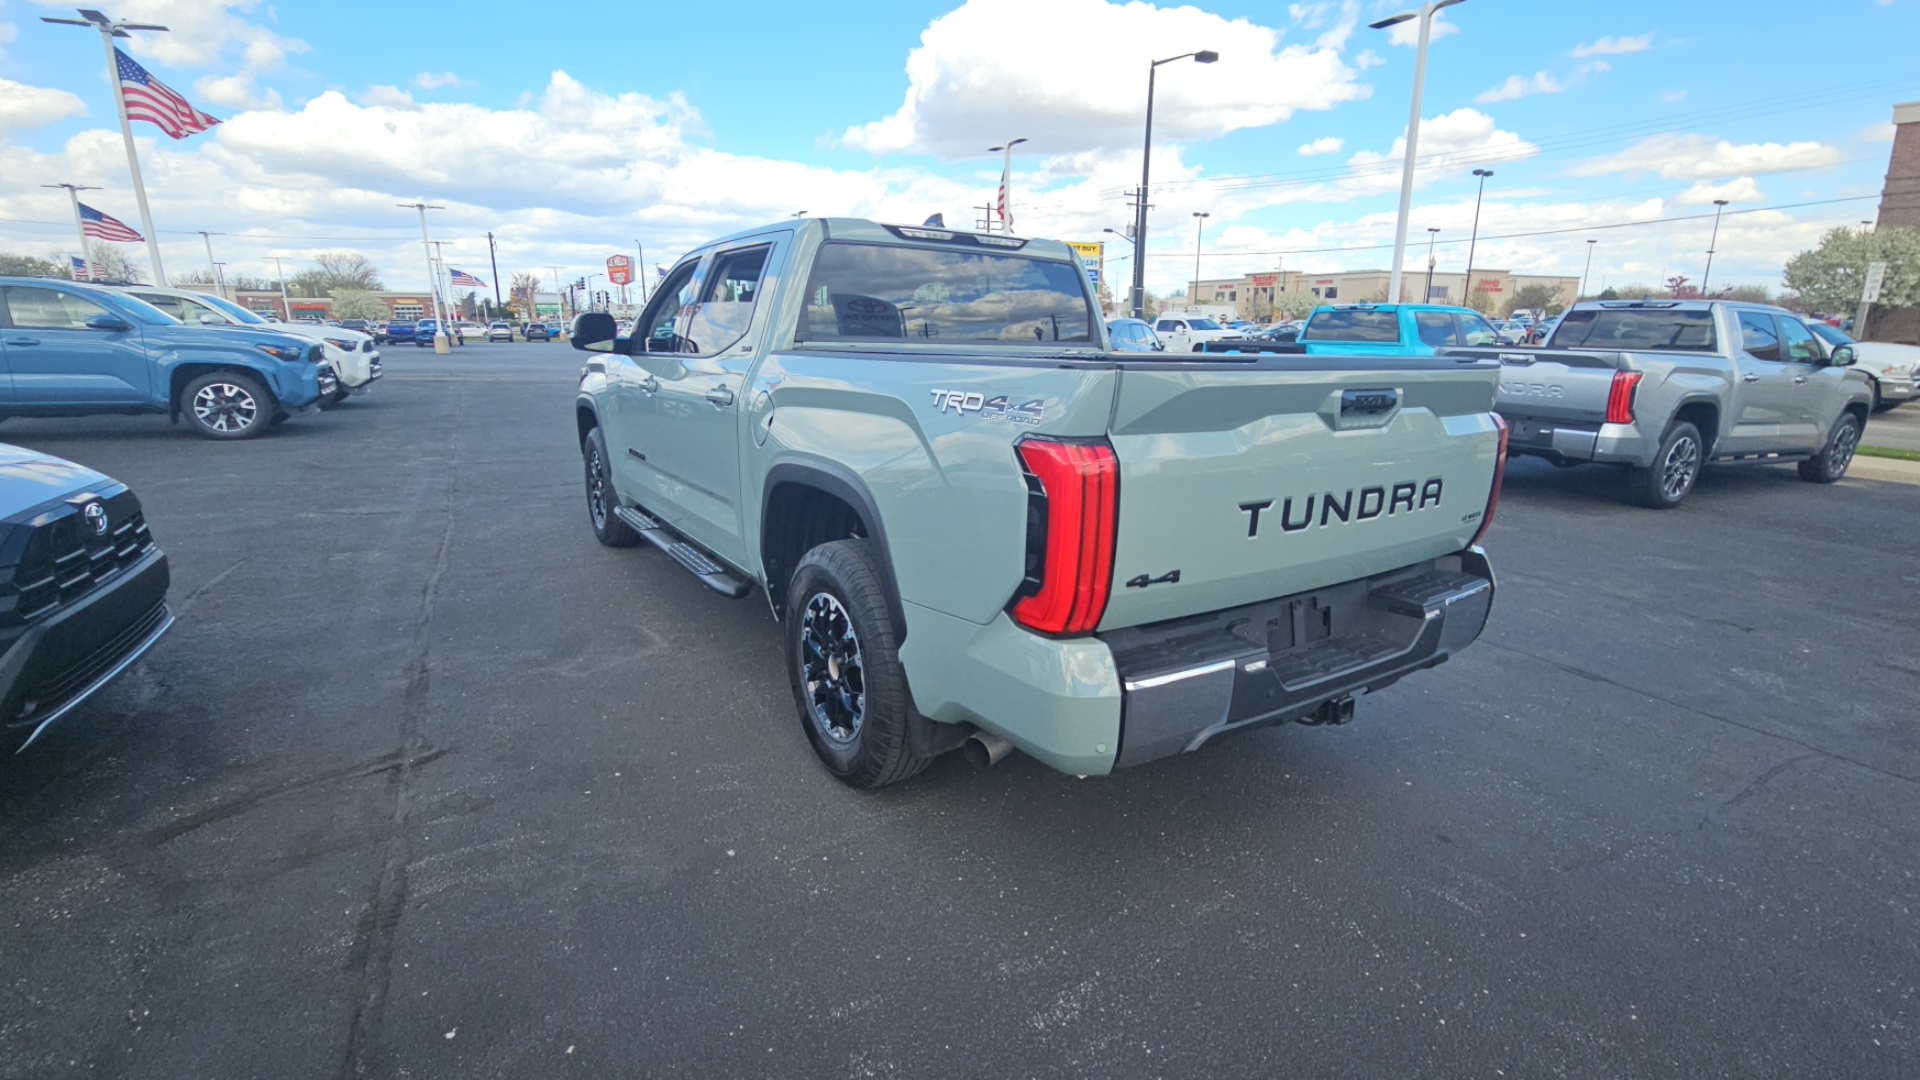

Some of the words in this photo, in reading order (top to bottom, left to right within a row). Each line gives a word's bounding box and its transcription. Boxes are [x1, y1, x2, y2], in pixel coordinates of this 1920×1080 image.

[930, 388, 985, 416] TRD
[983, 395, 1045, 419] 4x4
[1499, 381, 1564, 398] NDRA
[1238, 476, 1444, 539] TUNDRA
